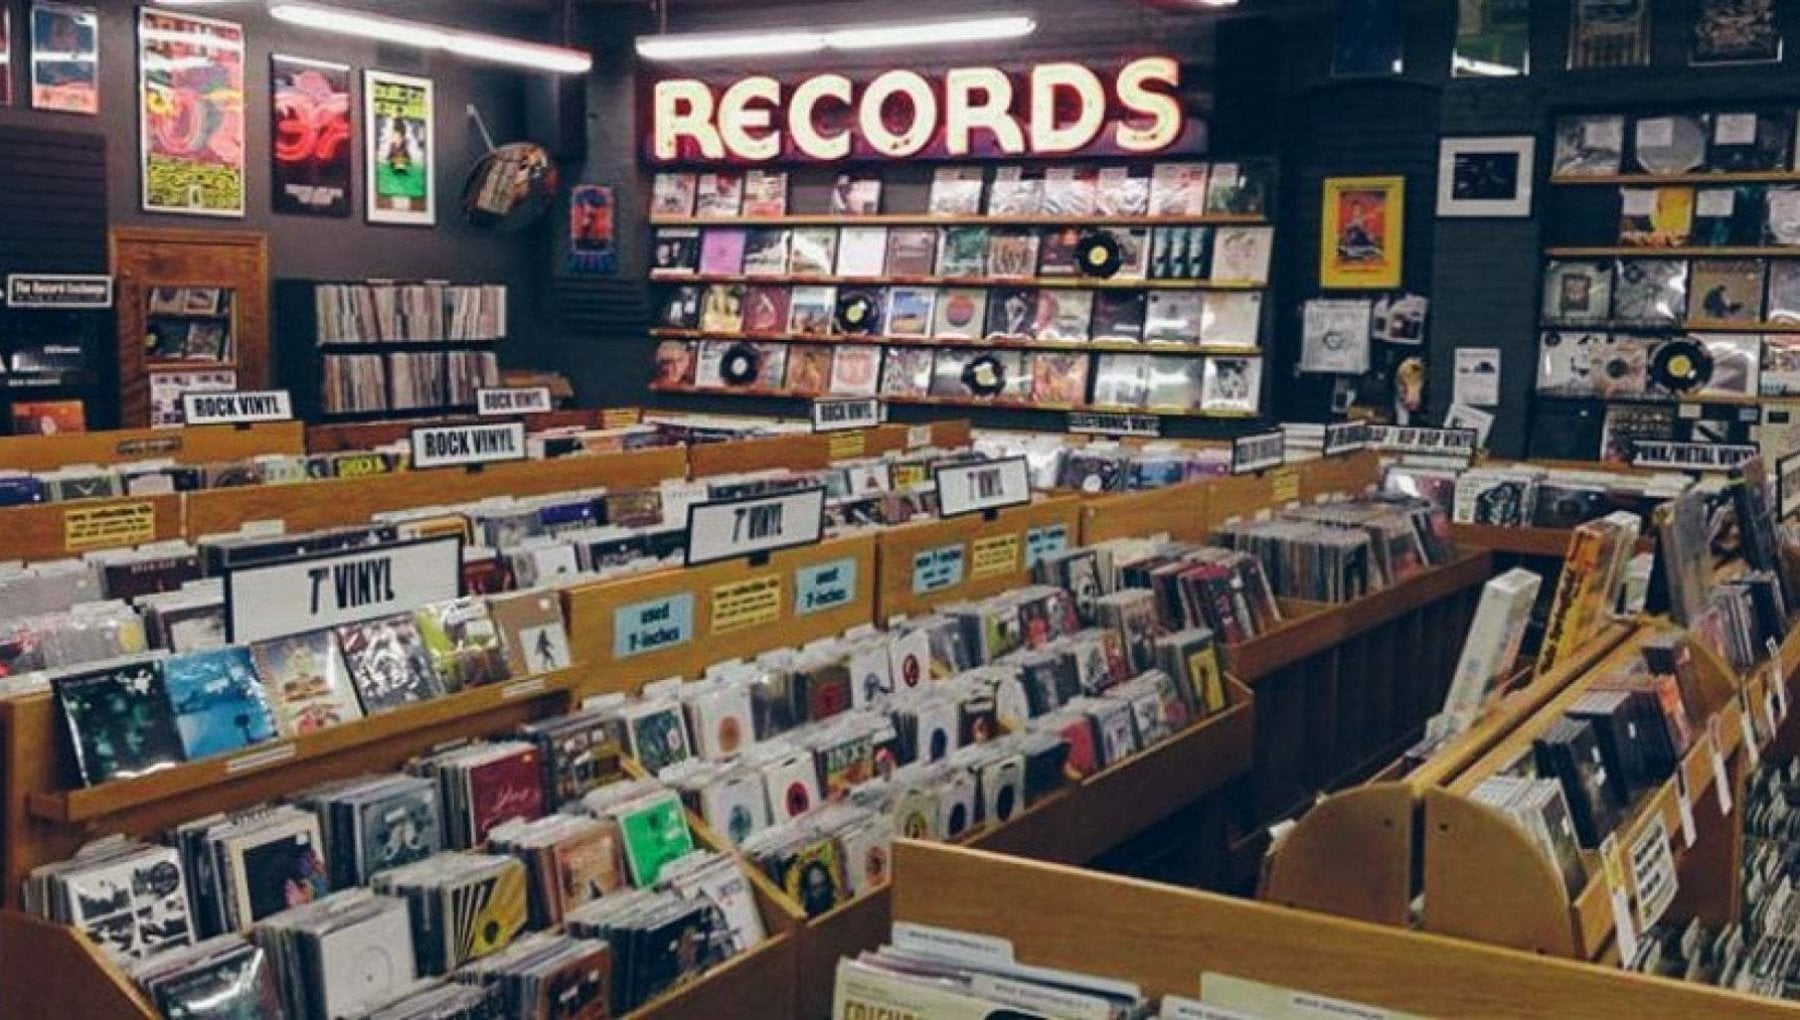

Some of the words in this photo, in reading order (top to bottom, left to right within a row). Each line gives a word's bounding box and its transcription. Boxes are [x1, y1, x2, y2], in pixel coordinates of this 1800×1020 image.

[653, 56, 1180, 160] RECORDS
[194, 398, 238, 418] ROCK
[239, 395, 280, 415] VINYL
[424, 431, 470, 457] ROCK
[471, 427, 515, 454] VINYL
[334, 556, 395, 609] VINYL
[640, 602, 670, 624] used
[629, 626, 681, 651] 7-inches
